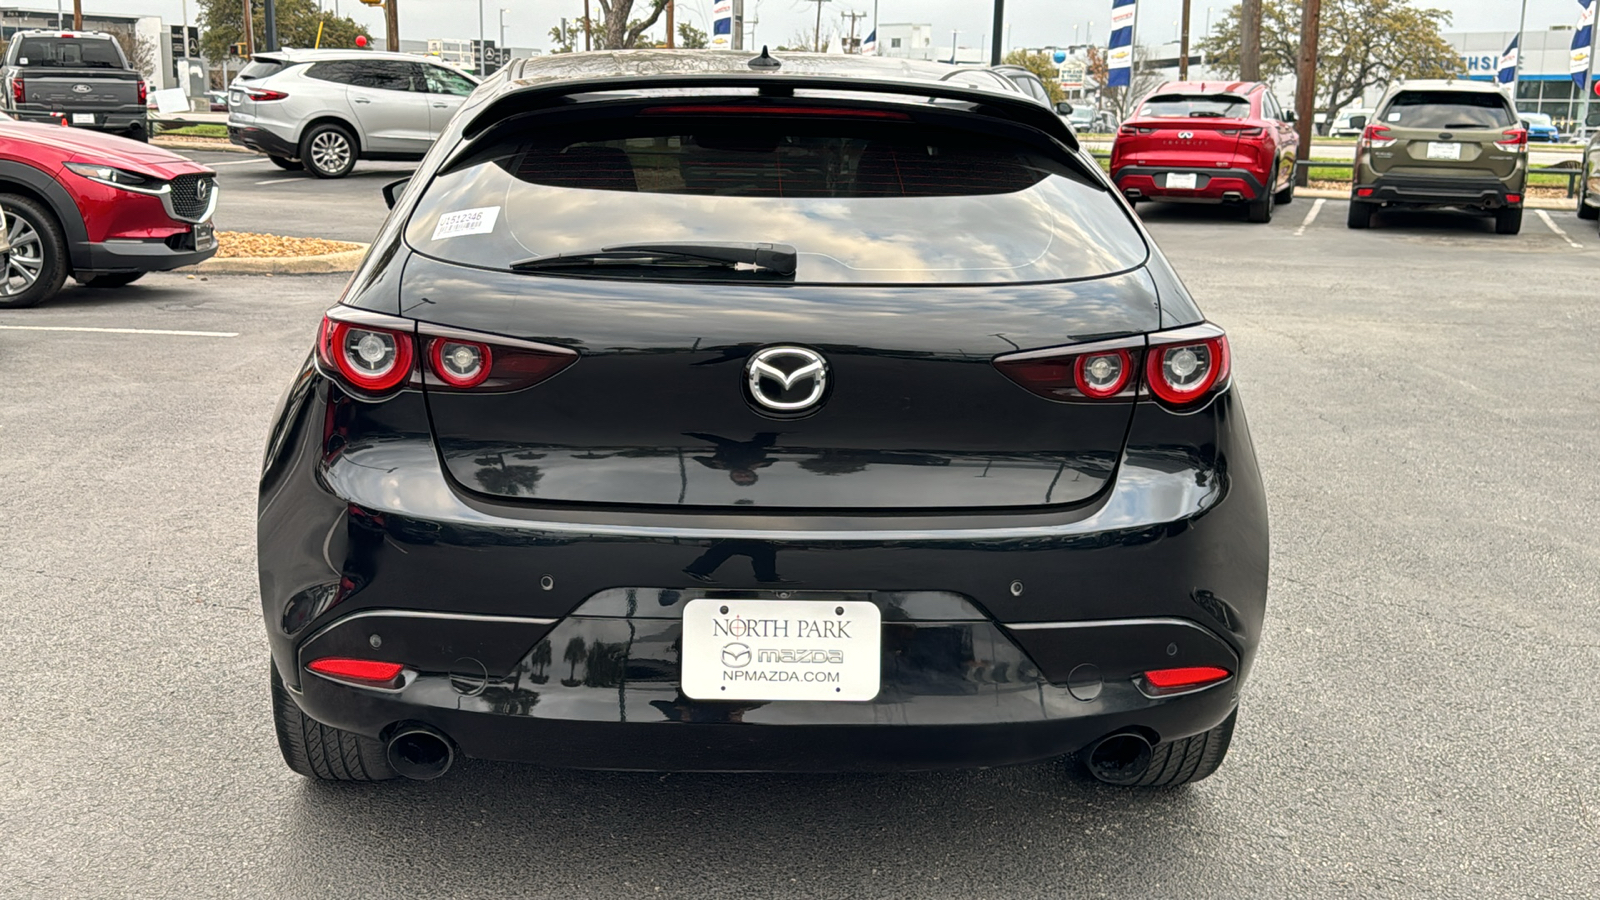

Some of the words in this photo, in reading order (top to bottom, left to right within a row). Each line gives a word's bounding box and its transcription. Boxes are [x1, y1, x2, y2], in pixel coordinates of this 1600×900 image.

[712, 615, 790, 637] NORTH
[797, 619, 852, 637] PARK
[757, 648, 844, 664] mazda
[722, 670, 841, 683] NPMAZDA.COM
